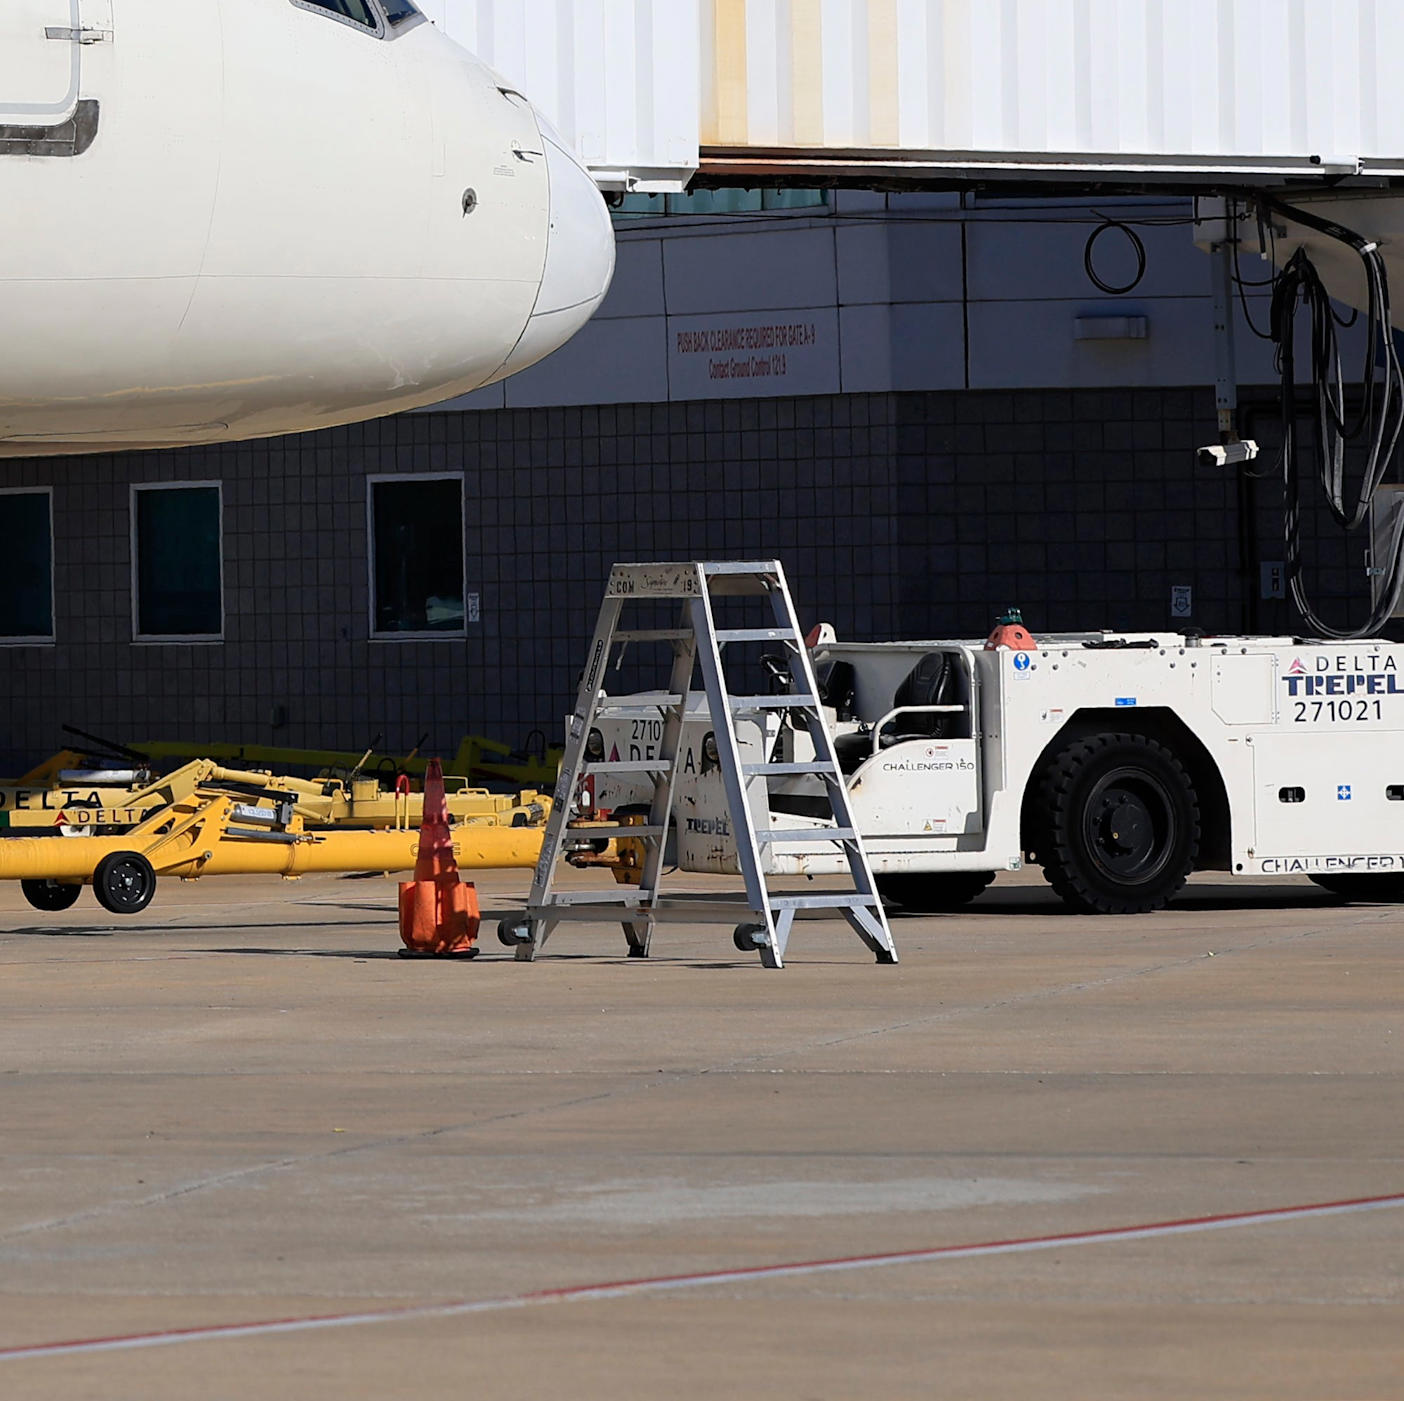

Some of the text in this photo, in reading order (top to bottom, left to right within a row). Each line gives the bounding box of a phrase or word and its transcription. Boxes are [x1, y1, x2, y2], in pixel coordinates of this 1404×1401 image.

[1316, 655, 1397, 672] DELTA
[1282, 674, 1404, 696] TREPEL
[1294, 700, 1381, 722] 271021
[632, 720, 666, 741] 2710
[883, 762, 974, 771] CHALLENGER 150
